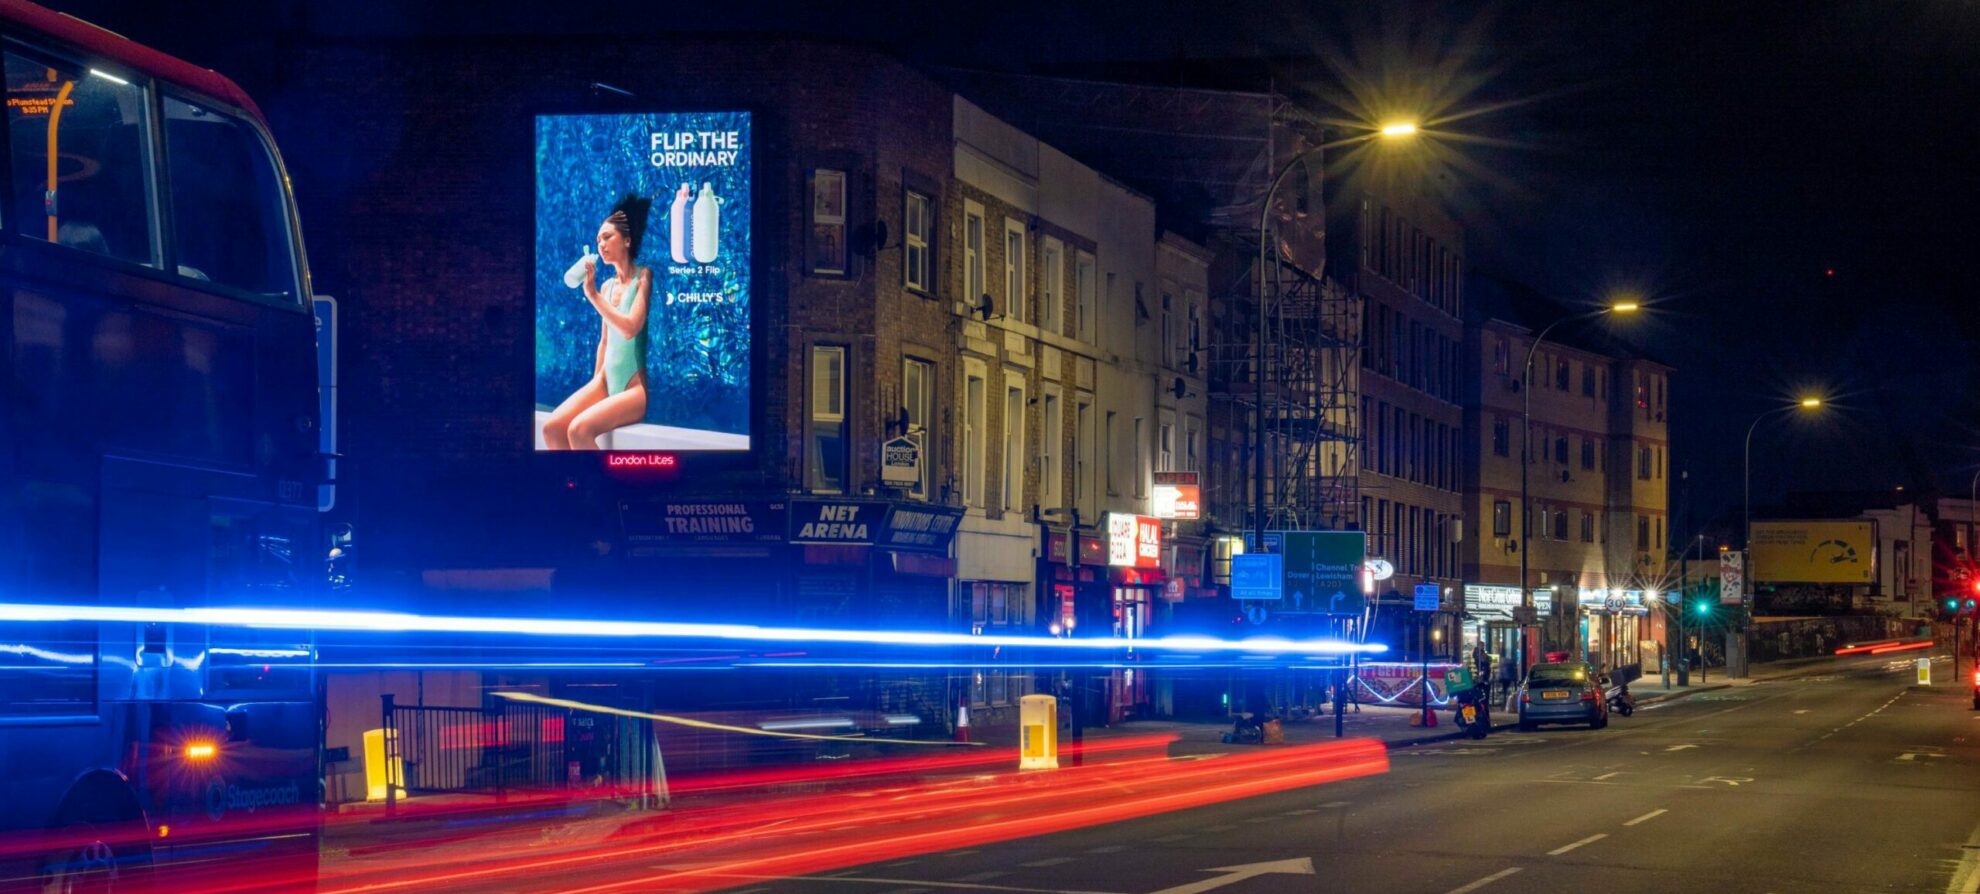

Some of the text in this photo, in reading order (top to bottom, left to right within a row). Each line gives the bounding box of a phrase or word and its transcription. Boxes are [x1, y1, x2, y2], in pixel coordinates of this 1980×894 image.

[651, 131, 739, 150] FLIP THE
[650, 151, 738, 167] ORDINARY
[669, 266, 720, 276] Series 2 Flip
[677, 292, 723, 303] CHILLY'S
[610, 455, 674, 465] London Lites
[1155, 473, 1196, 484] OPEN
[667, 503, 747, 516] PROFESSIONAL
[769, 503, 785, 511] GCSE
[819, 505, 860, 522] NET
[664, 516, 754, 534] TRAINING
[798, 522, 868, 539] ARENA
[1315, 563, 1348, 572] Channel
[1287, 571, 1311, 580] Dover
[1315, 572, 1353, 580] Lewisham
[1608, 599, 1622, 608] 30
[227, 779, 300, 814] Stagecoach
